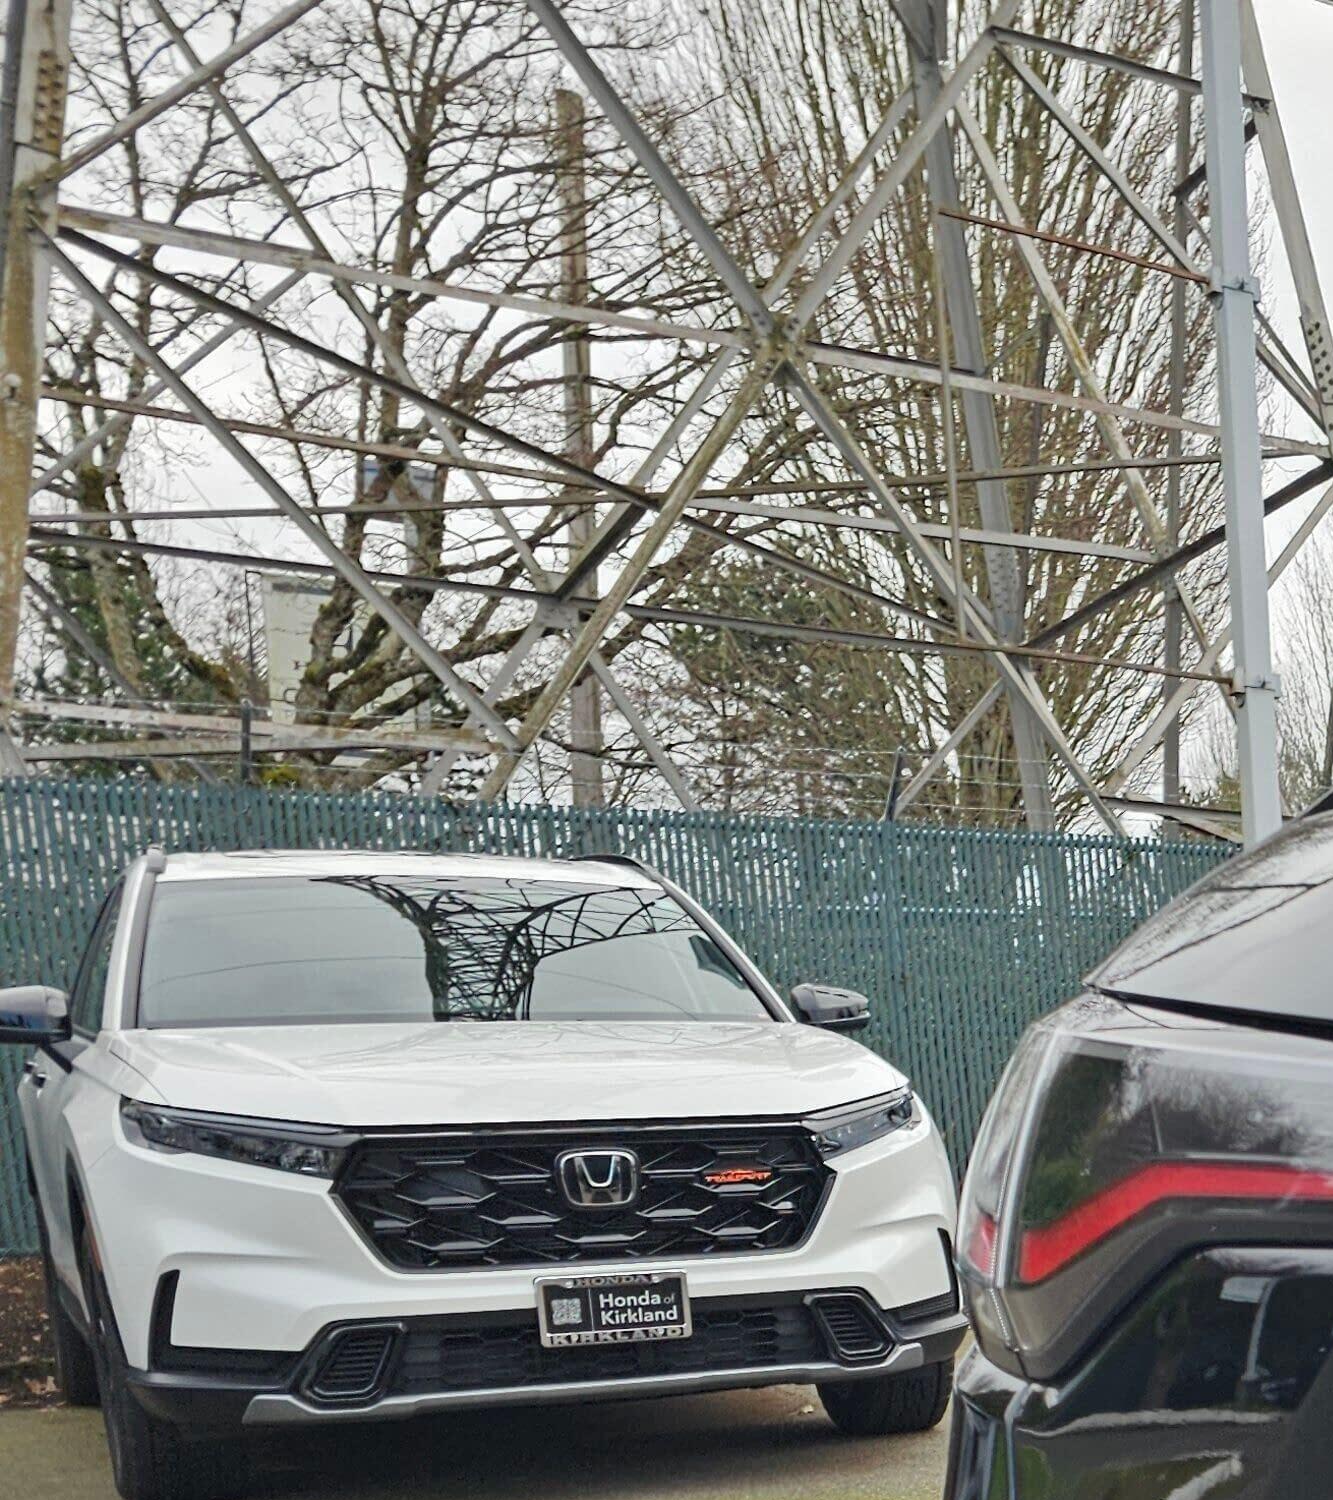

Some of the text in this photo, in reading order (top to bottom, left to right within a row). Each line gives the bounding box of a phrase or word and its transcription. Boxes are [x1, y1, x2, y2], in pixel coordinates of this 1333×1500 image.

[599, 1290, 675, 1309] Honda of
[601, 1306, 678, 1325] Kirkland
